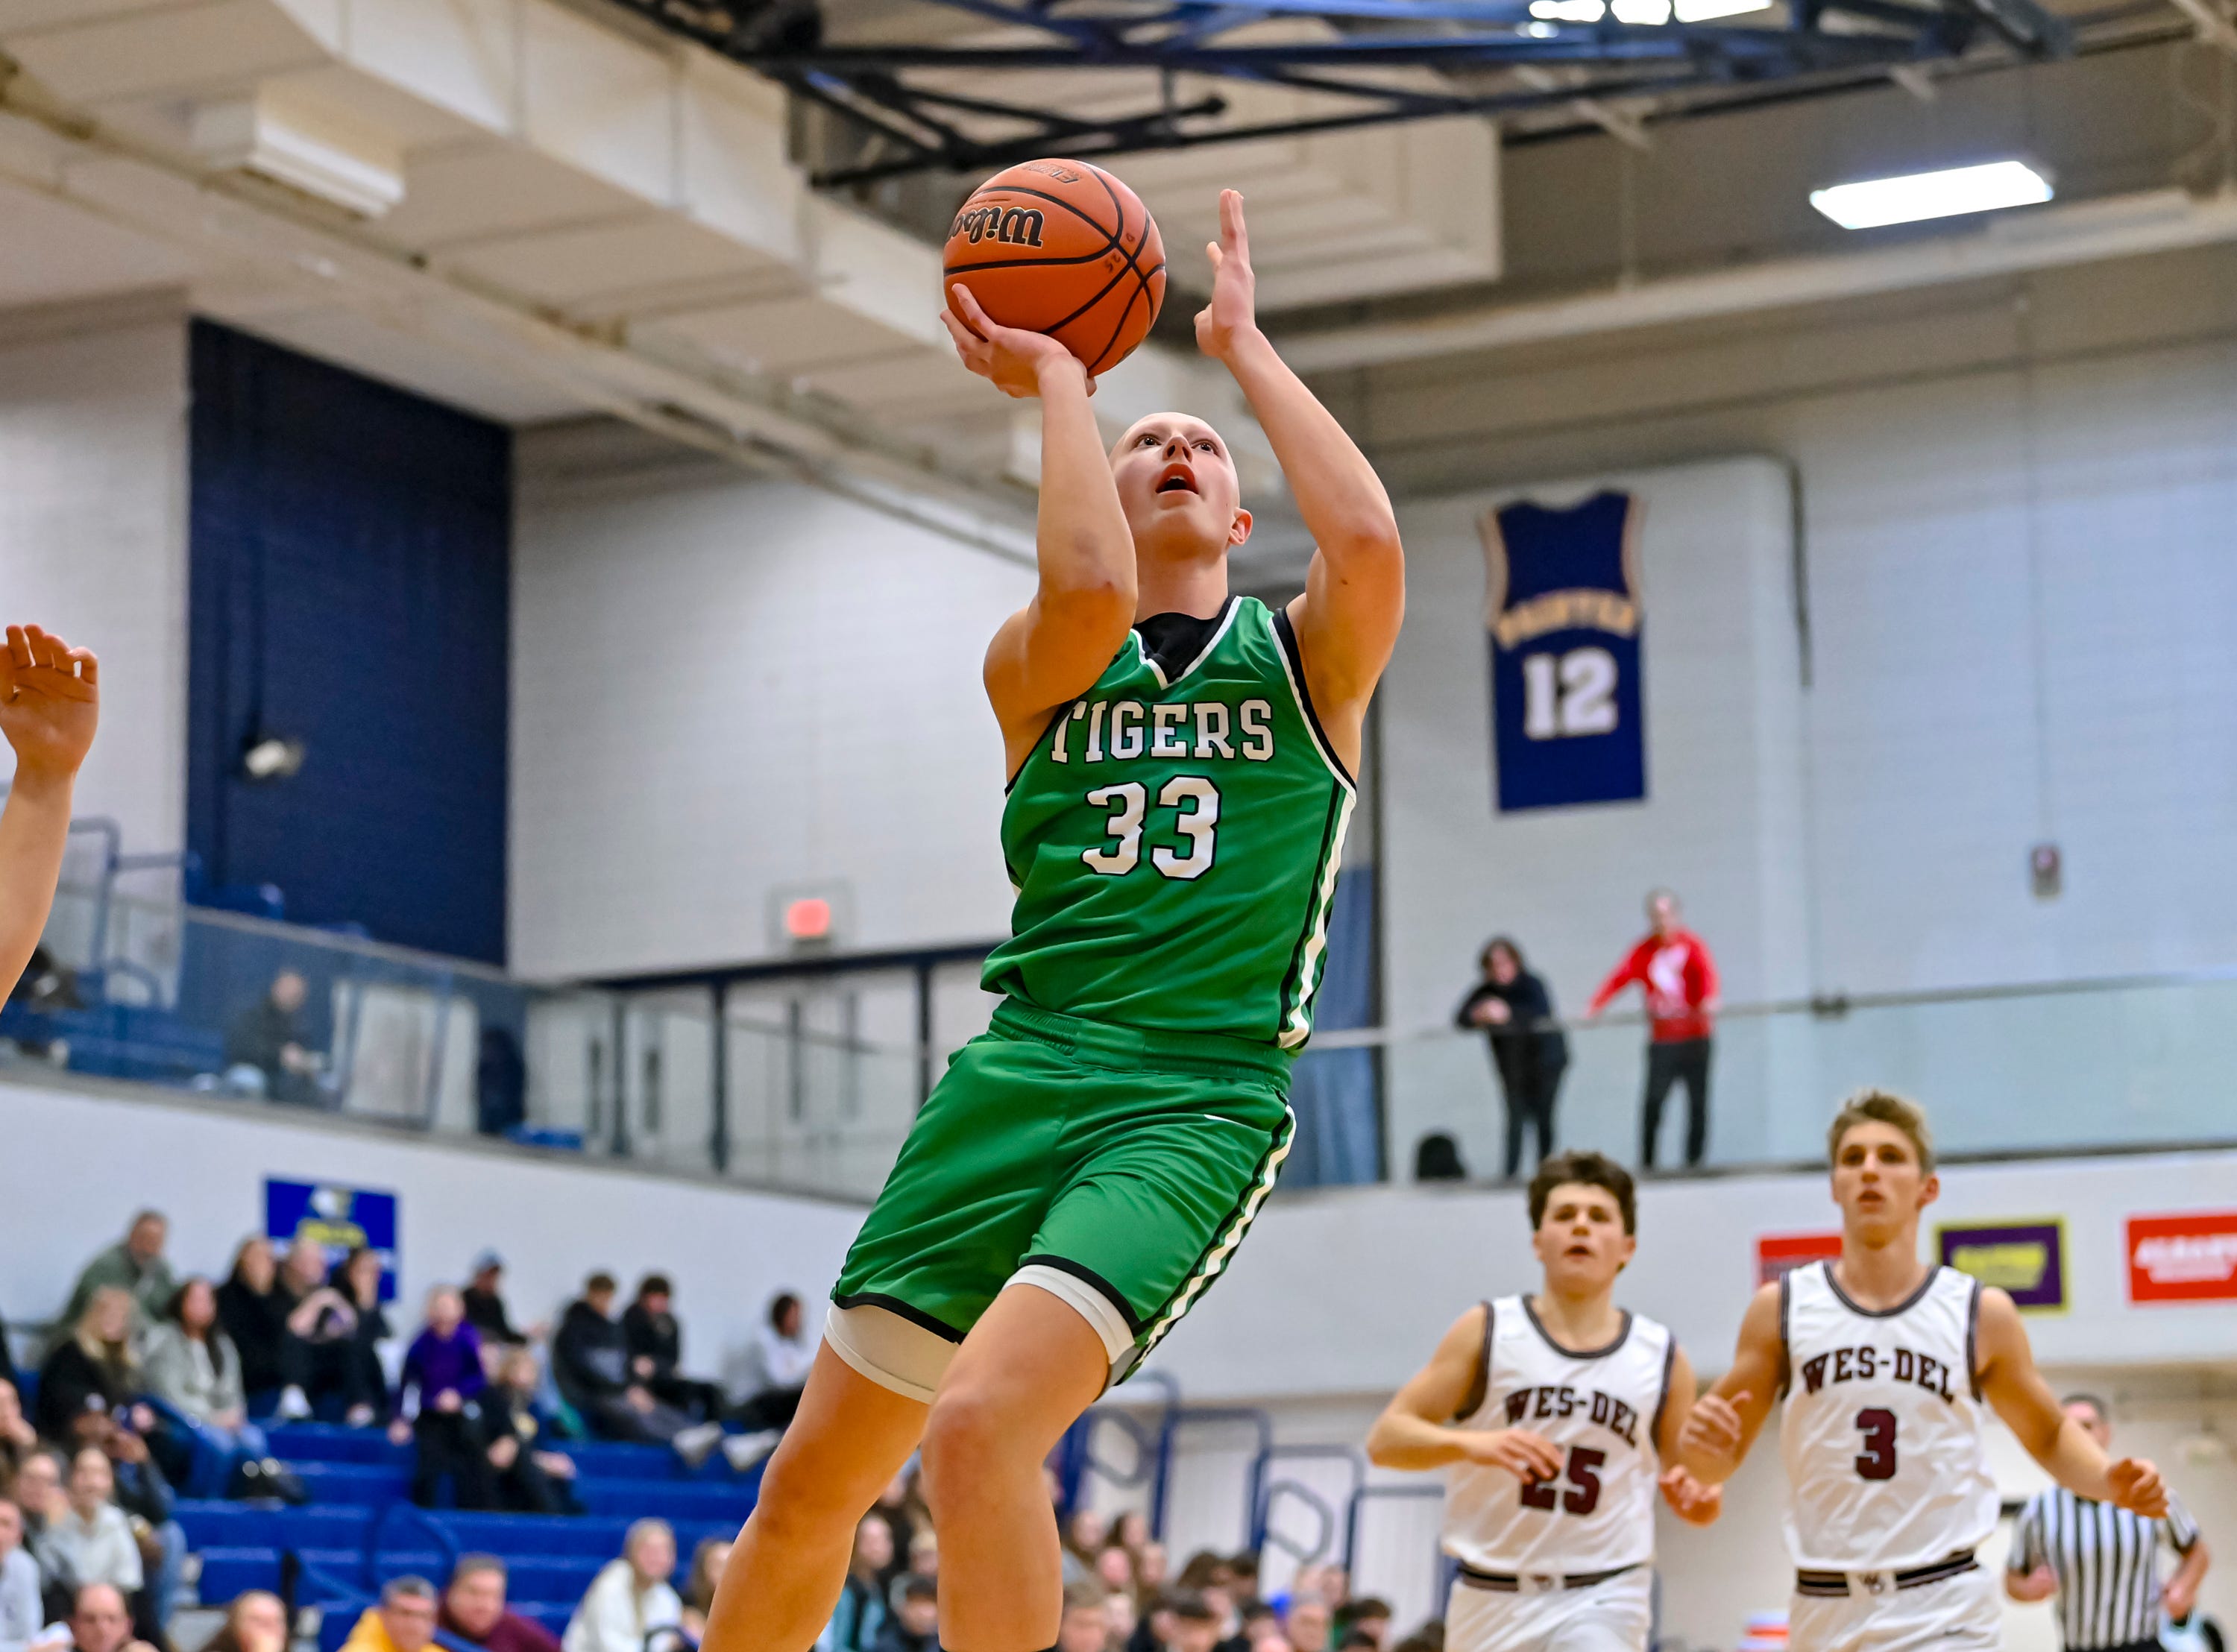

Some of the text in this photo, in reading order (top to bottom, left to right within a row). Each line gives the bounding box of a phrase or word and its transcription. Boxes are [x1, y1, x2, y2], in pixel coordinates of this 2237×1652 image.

[946, 206, 1044, 248] Wilso
[1523, 647, 1618, 740] 12
[1081, 775, 1221, 880] 33
[1802, 1346, 1954, 1404] WES-DEL
[1505, 1385, 1638, 1449] WES-DEL
[1855, 1407, 1897, 1480] 3
